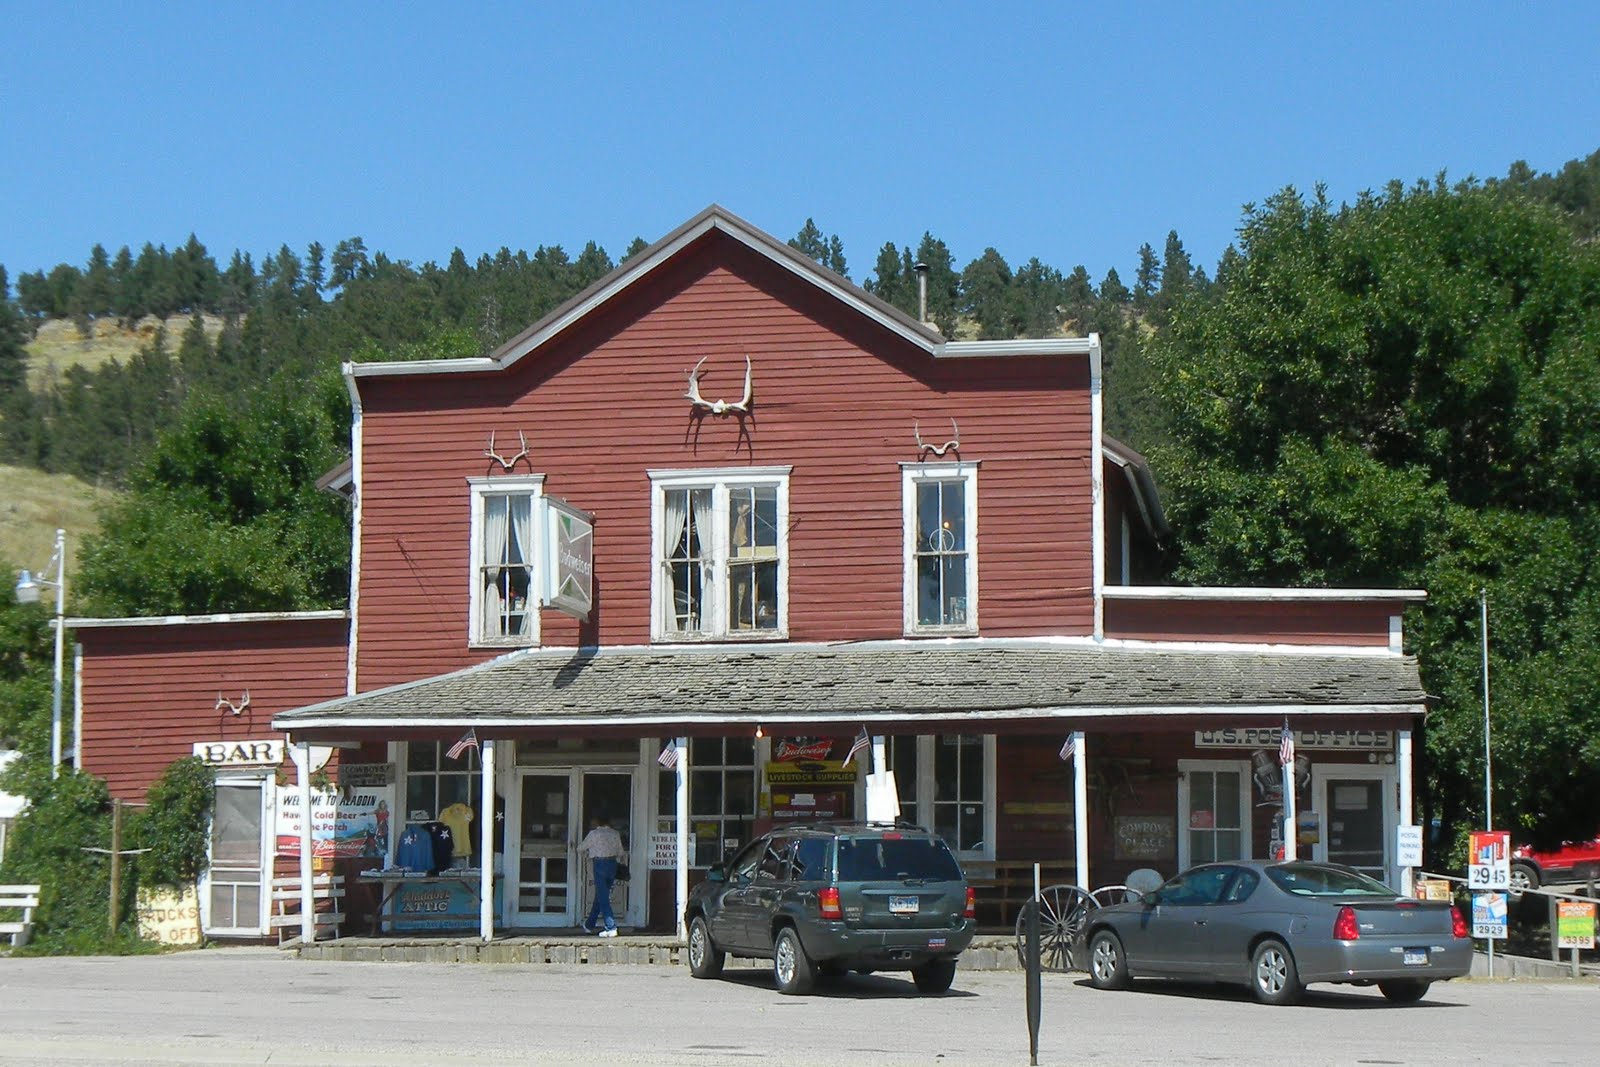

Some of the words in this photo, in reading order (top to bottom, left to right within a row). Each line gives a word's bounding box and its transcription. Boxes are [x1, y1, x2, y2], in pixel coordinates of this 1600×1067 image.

[1245, 730, 1283, 744] POS
[1301, 731, 1387, 746] OFFICE
[205, 742, 274, 762] BAR
[769, 773, 813, 781] LIVESTOCK
[816, 773, 855, 781] SUPPLIES
[340, 795, 377, 806] ALADDIN
[314, 811, 334, 820] Cold
[337, 811, 357, 820] Beer
[322, 823, 348, 832] Porch
[402, 902, 448, 911] ATTIC
[169, 928, 198, 941] OFF
